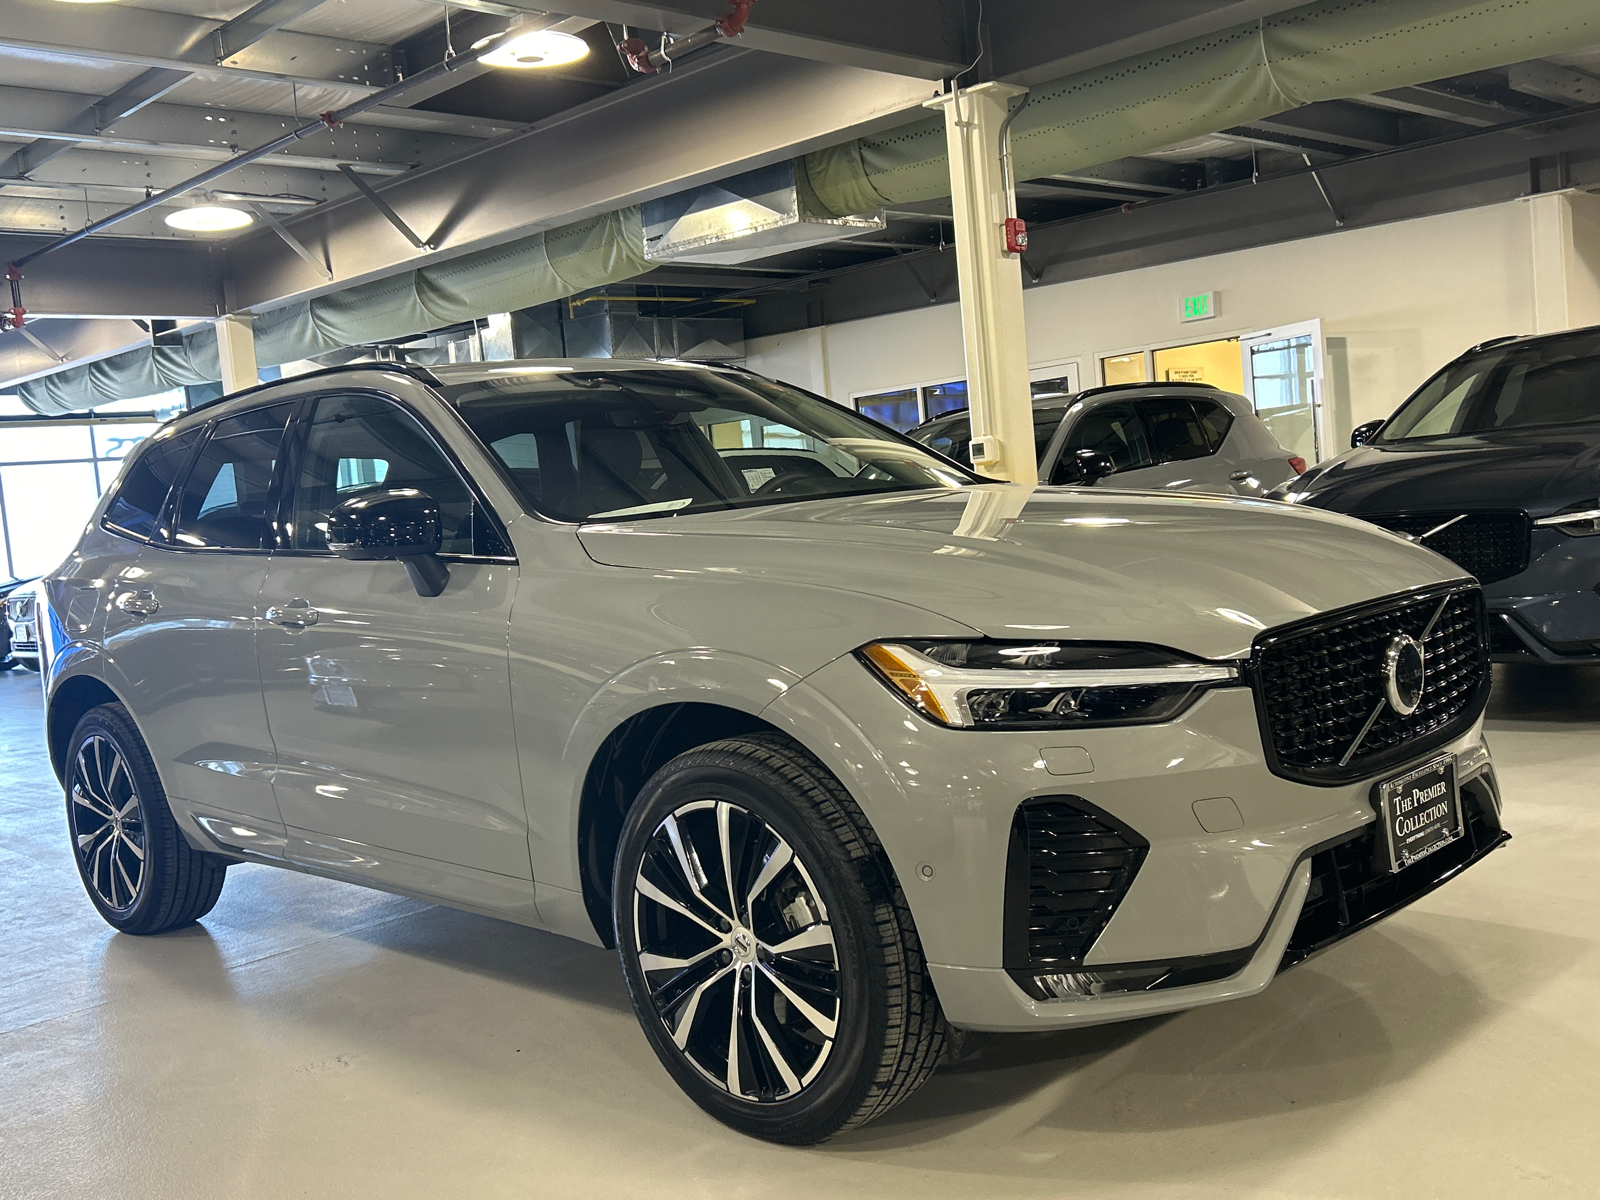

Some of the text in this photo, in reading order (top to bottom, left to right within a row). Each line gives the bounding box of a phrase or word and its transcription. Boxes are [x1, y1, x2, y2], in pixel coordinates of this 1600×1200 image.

[1185, 294, 1208, 318] EXIT
[1393, 781, 1447, 816] THE PREMIER
[1395, 801, 1448, 837] COLLECTION
